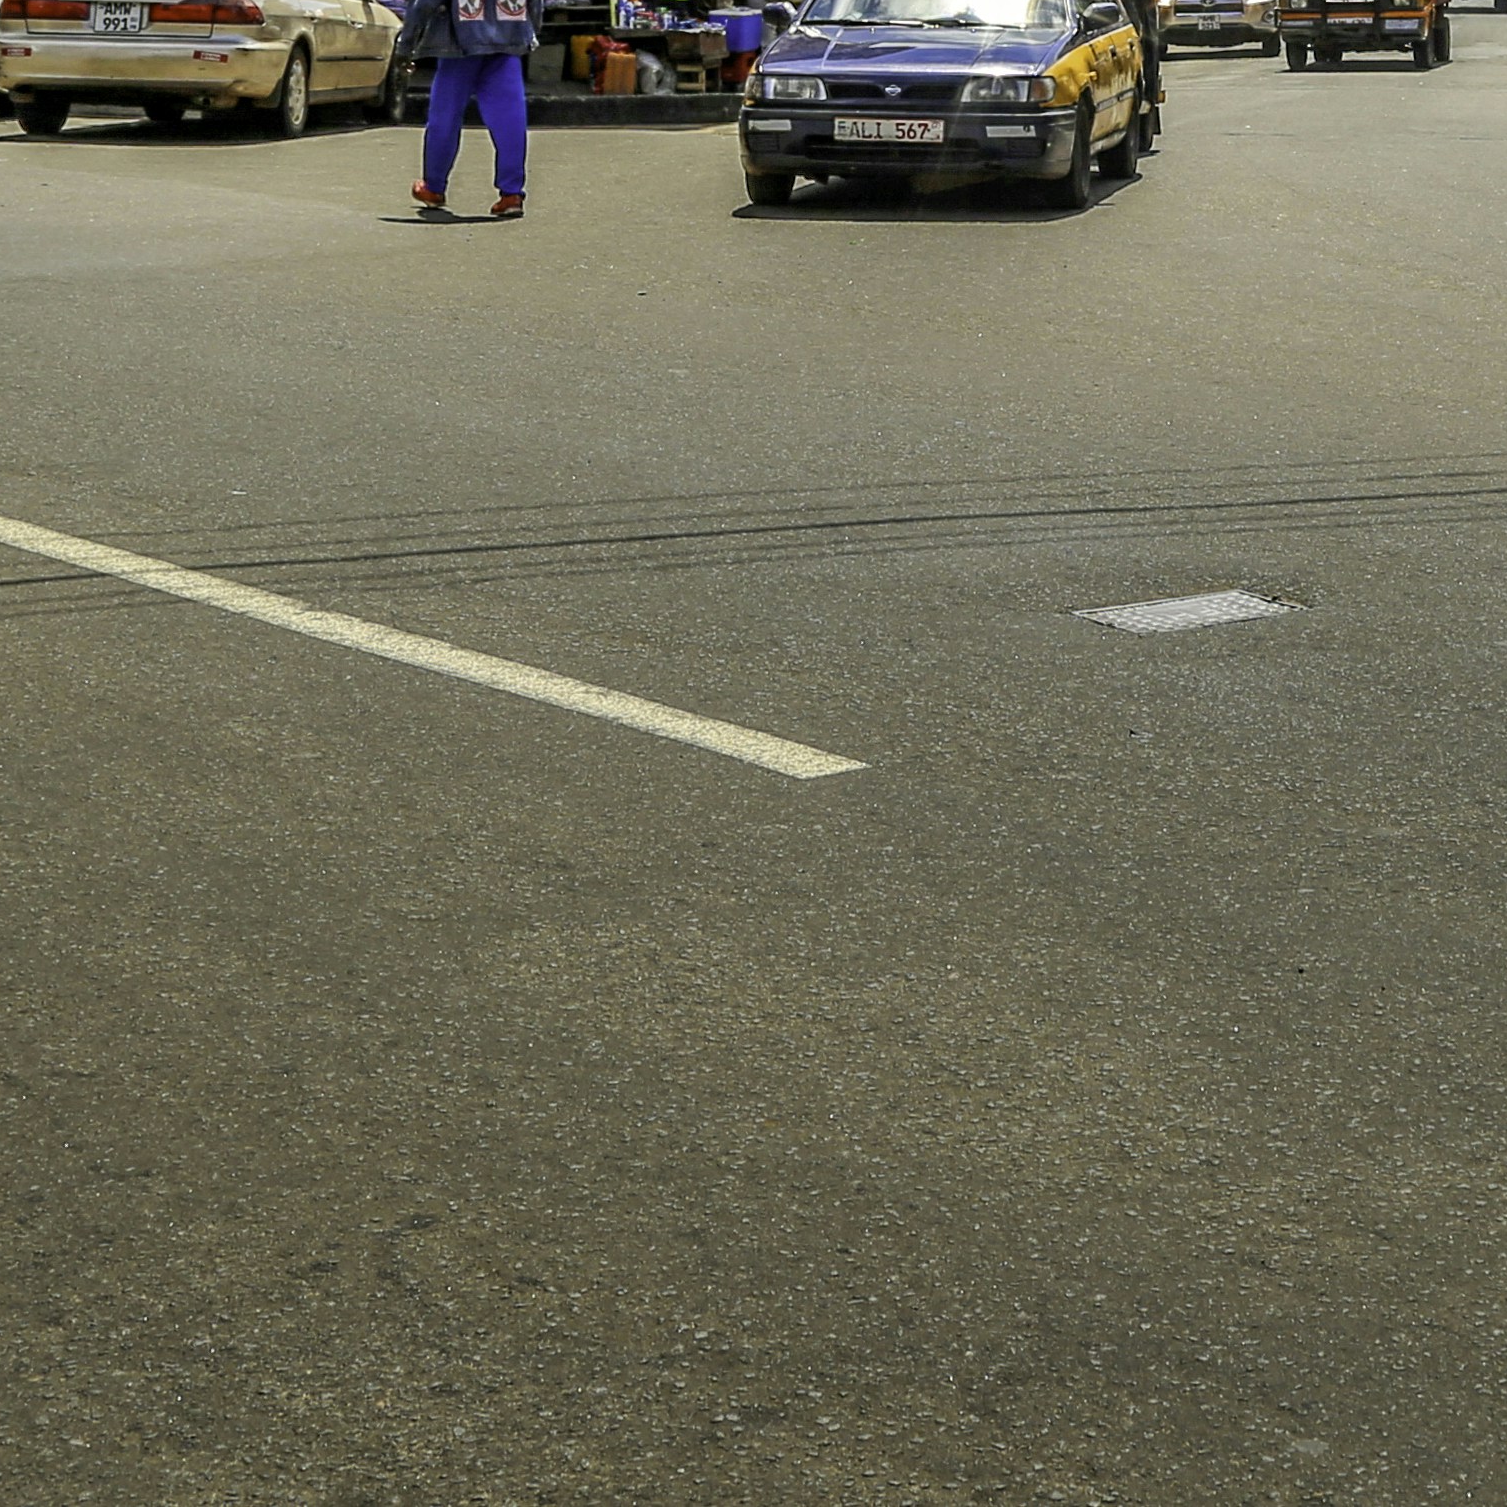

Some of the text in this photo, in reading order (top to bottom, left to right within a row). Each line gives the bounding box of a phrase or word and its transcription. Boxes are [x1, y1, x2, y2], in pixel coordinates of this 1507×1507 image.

[104, 2, 132, 15] AMW
[102, 17, 129, 31] 991
[849, 121, 929, 140] ALI 567
